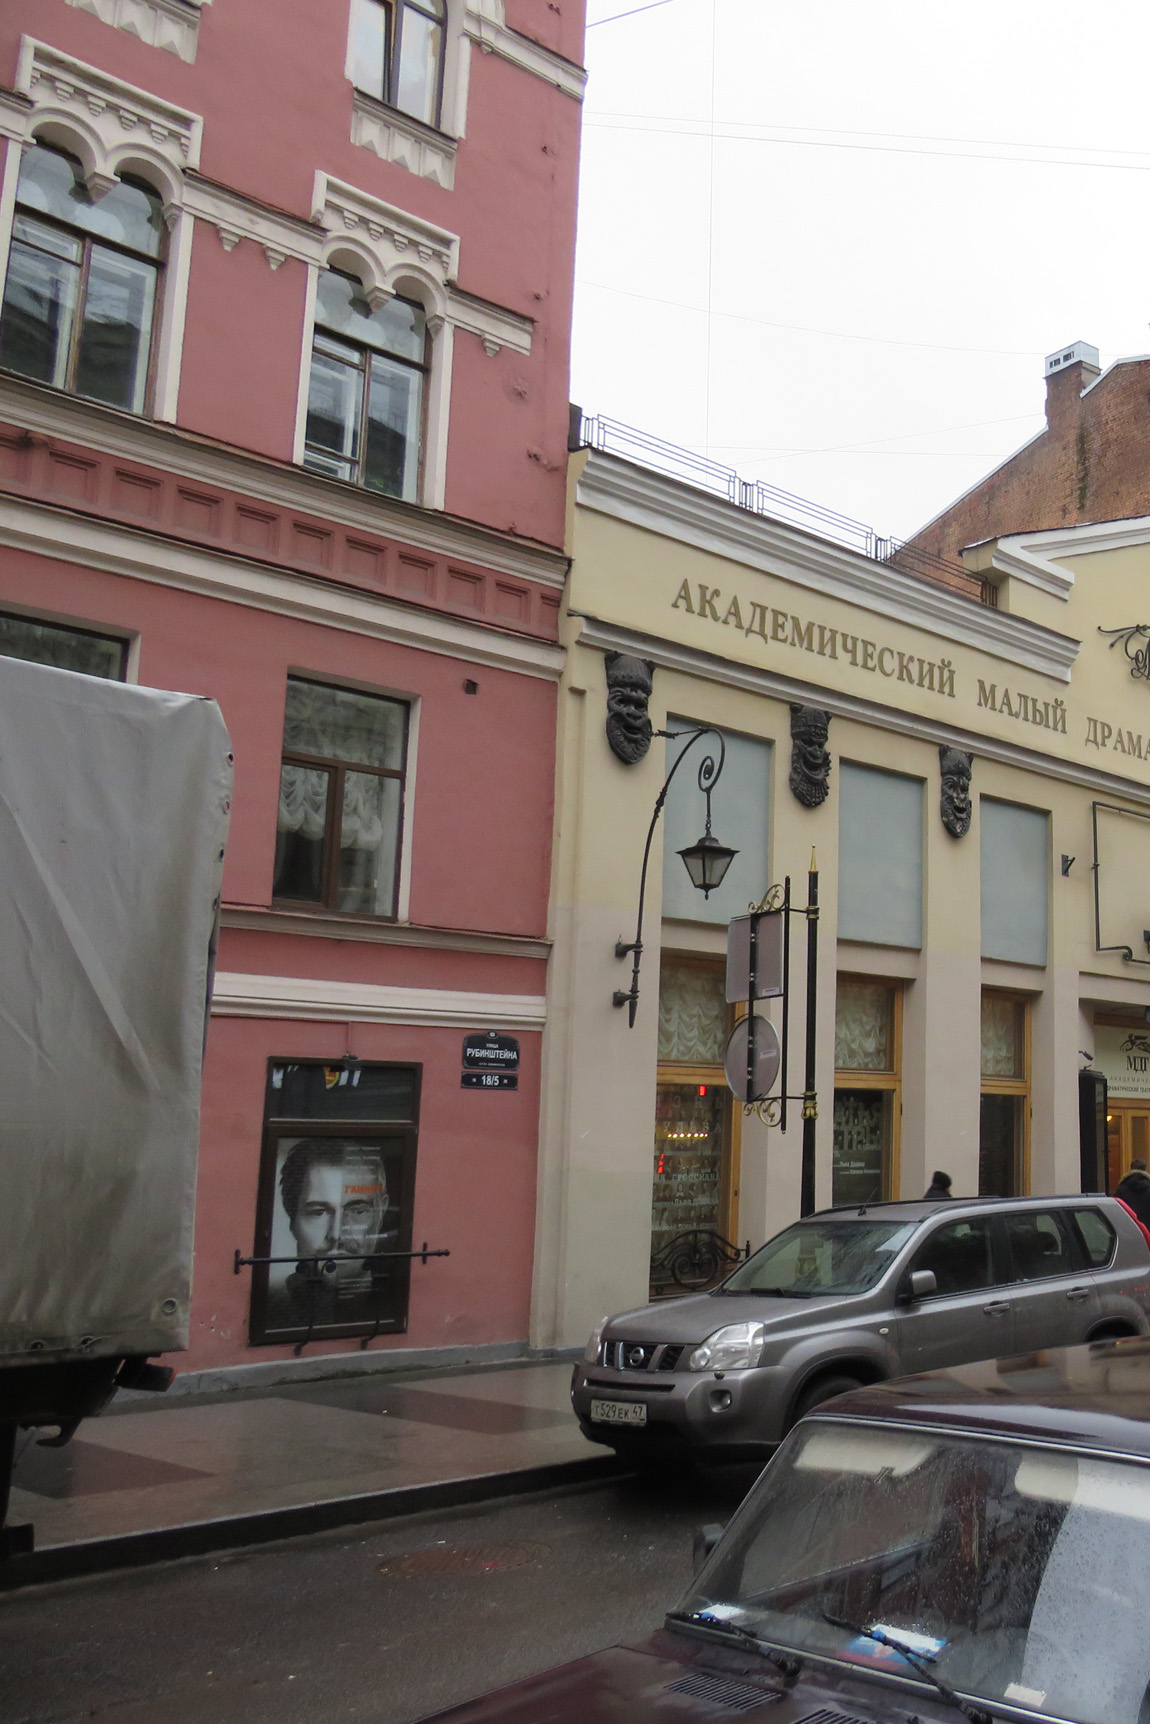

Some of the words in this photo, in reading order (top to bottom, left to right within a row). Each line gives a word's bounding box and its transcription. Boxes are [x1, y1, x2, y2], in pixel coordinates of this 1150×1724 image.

[671, 578, 956, 698] АКАДЕМИЧЕСКИЙ
[977, 679, 1067, 734] МАЛЫЙ
[466, 1048, 518, 1060] РУБИНШТЕЙНА
[481, 1075, 500, 1086] 18/5
